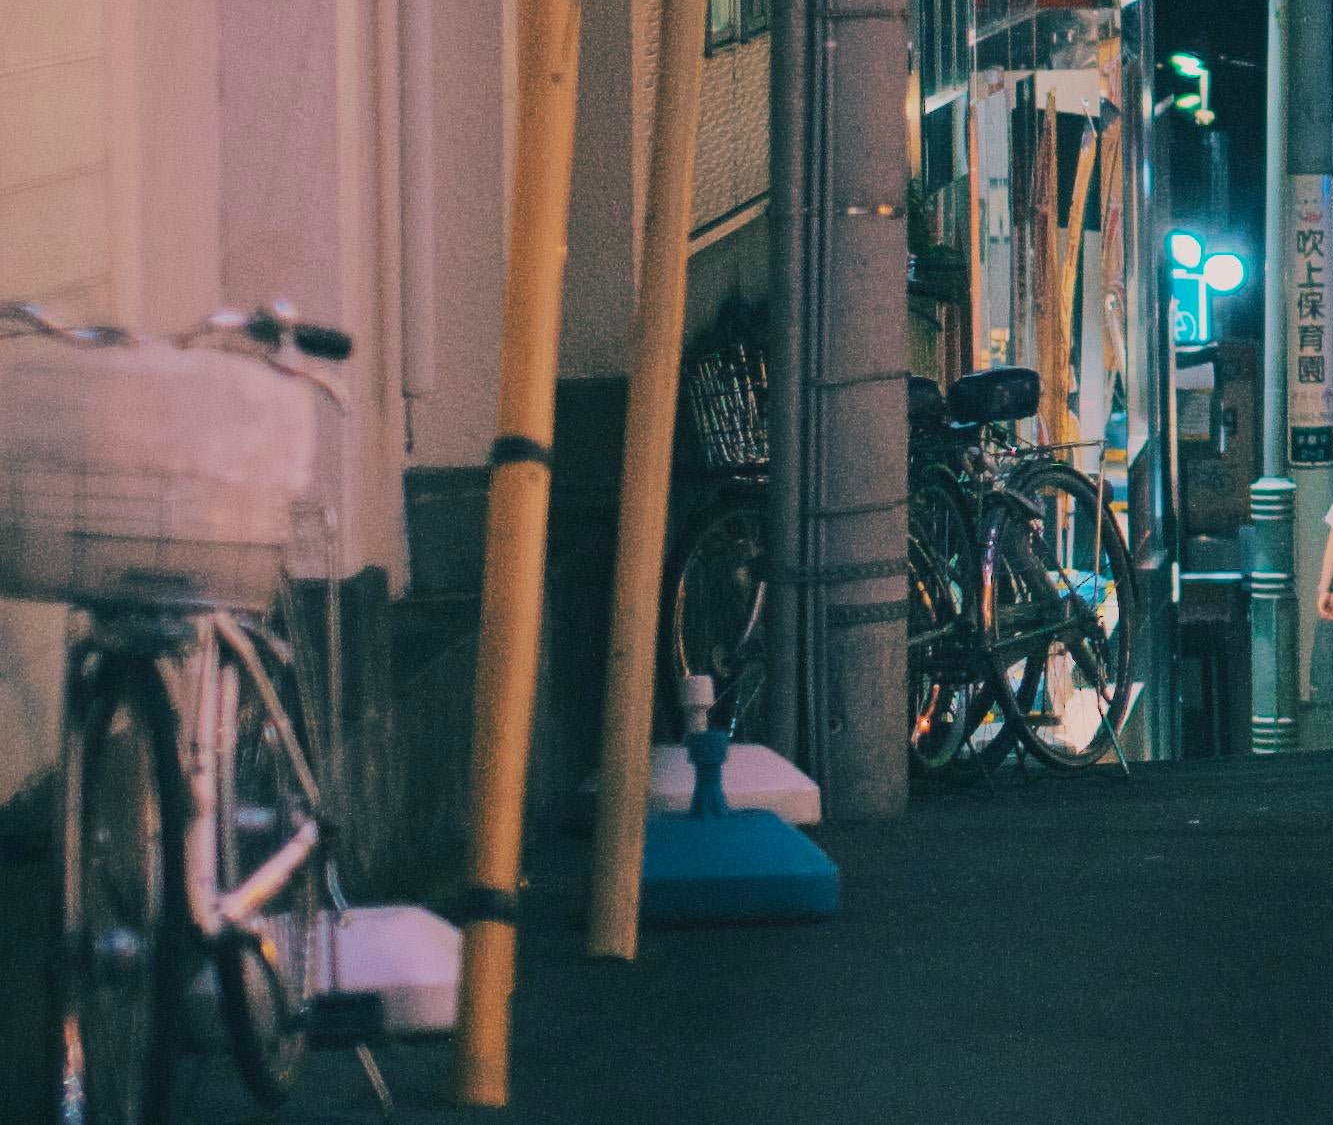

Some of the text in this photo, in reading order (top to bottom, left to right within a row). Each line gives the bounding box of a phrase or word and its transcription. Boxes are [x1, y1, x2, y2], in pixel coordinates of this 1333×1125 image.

[1295, 228, 1326, 385] 吹上保育園
